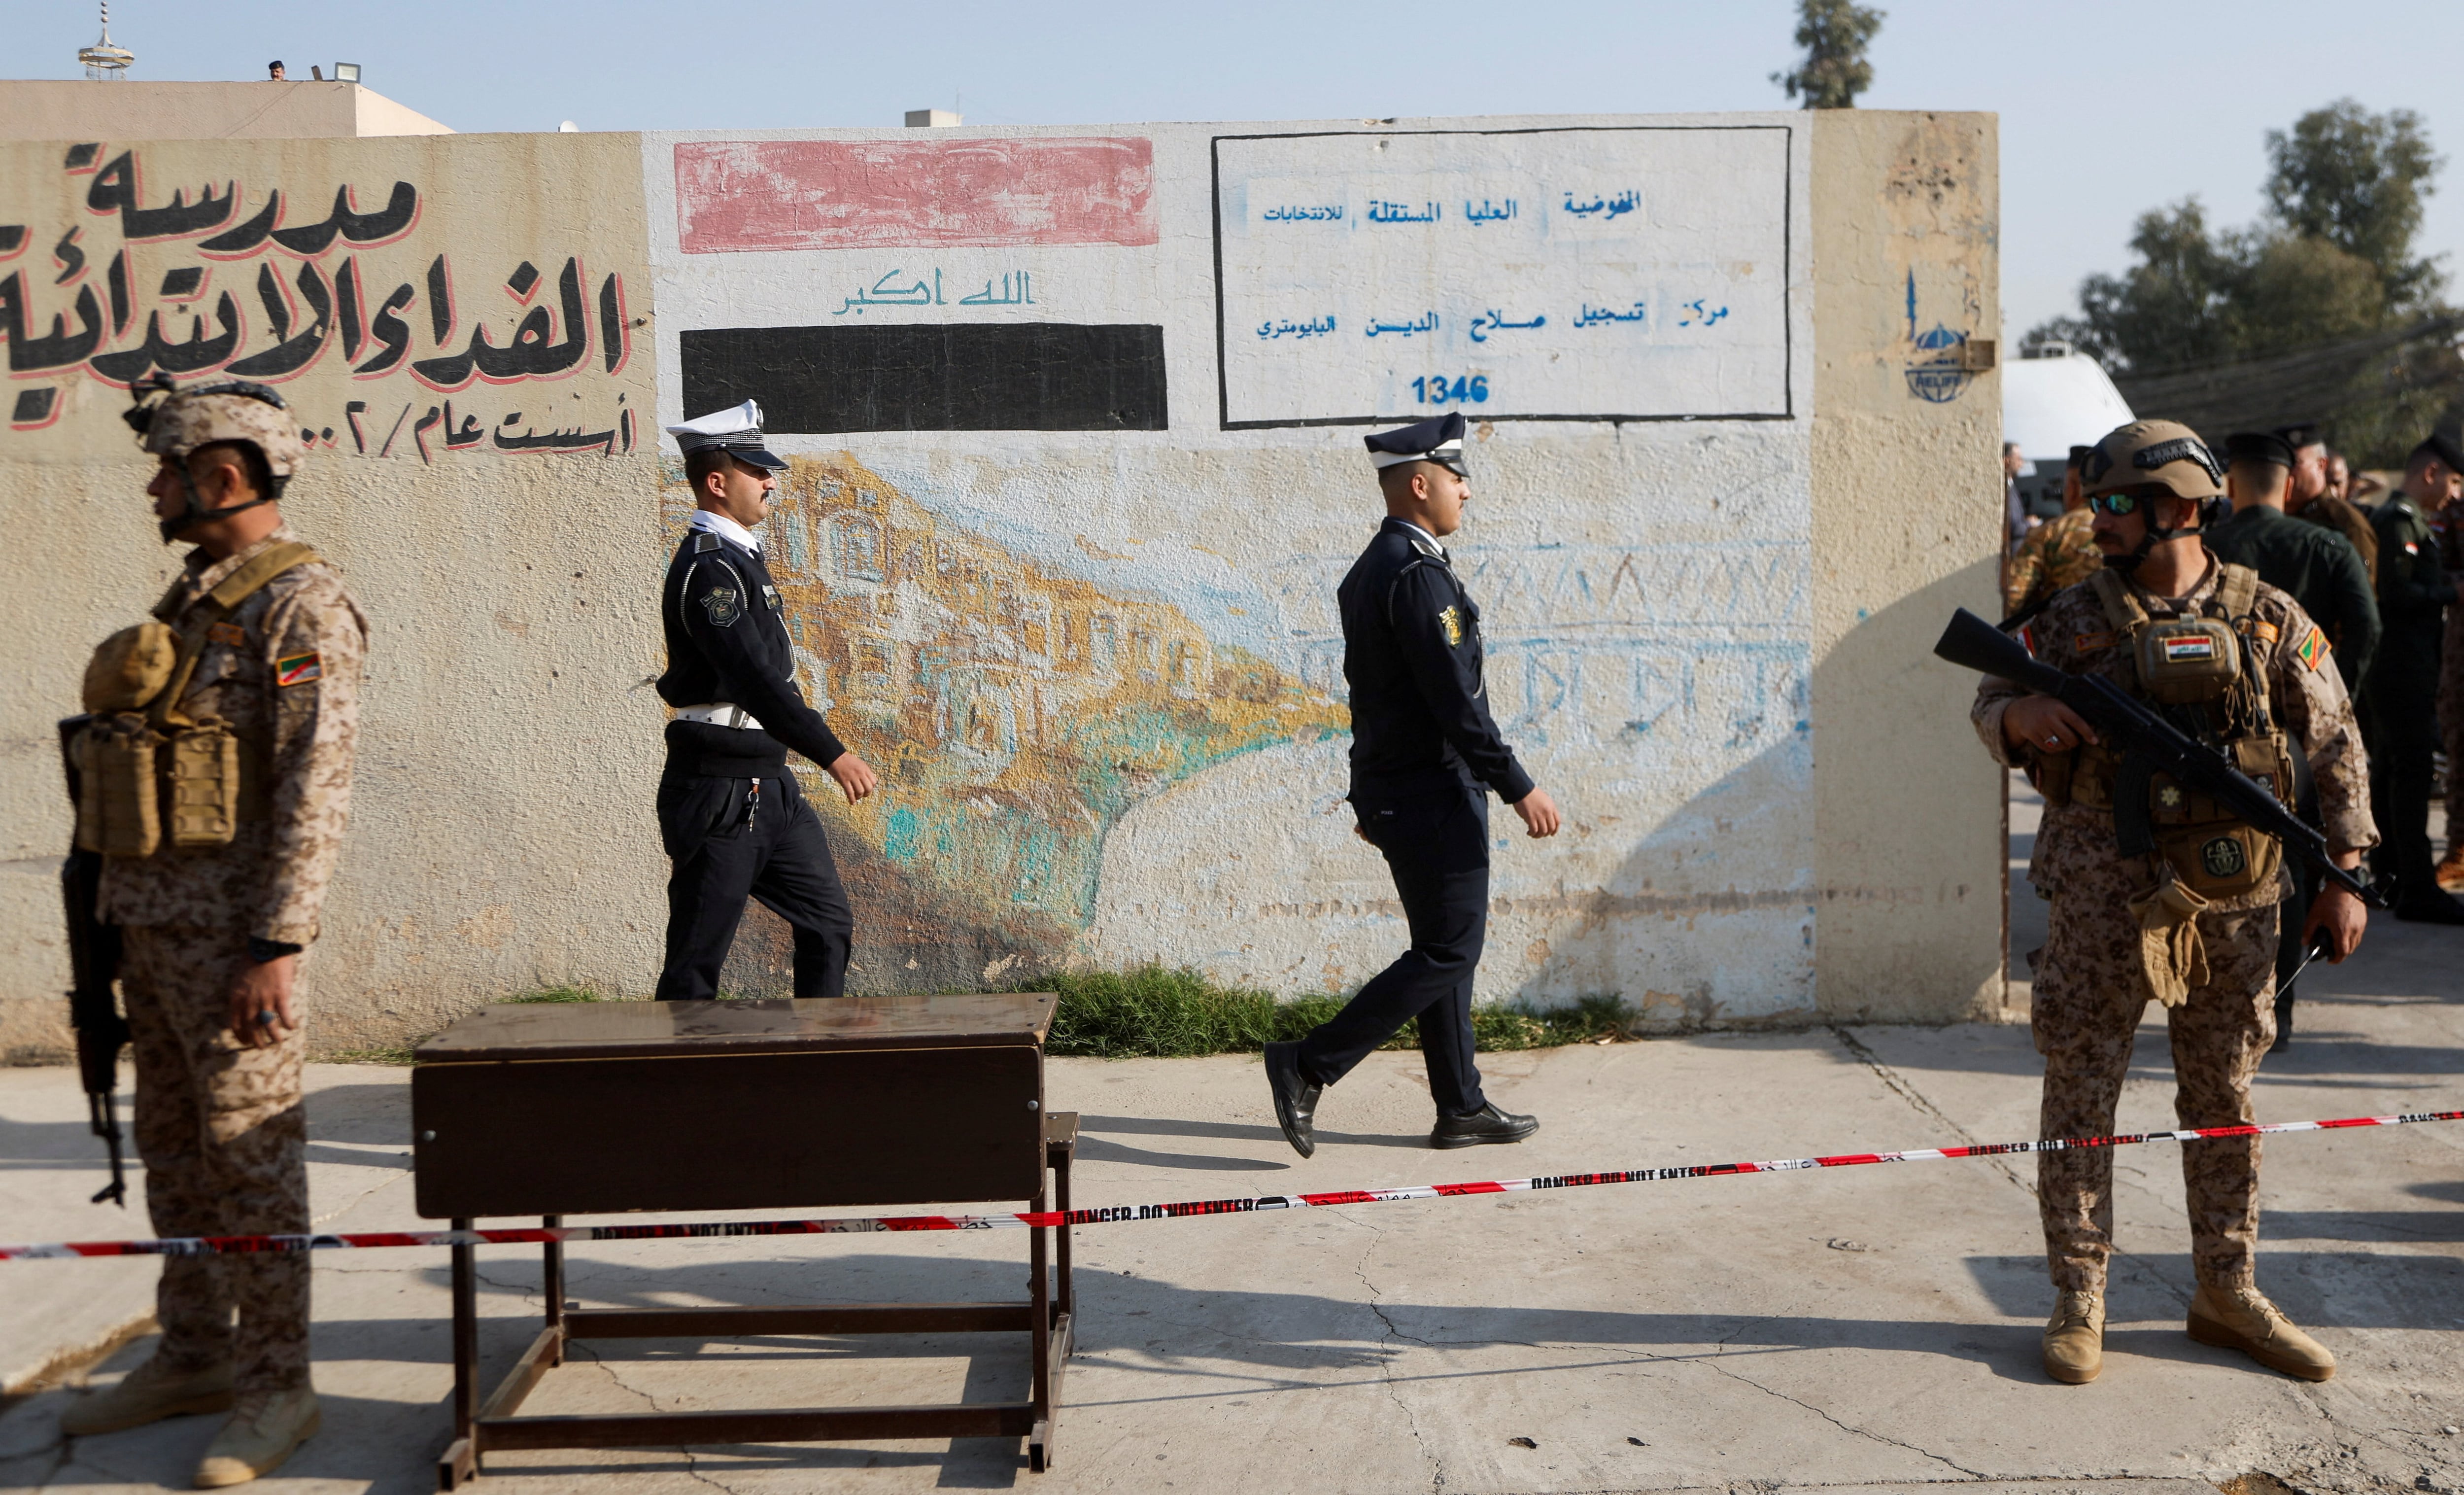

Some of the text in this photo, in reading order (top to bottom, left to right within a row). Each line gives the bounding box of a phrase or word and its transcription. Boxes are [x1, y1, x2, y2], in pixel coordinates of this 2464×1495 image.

[63, 143, 424, 261] مدرسة
[1263, 205, 1343, 222] للانتخابات
[1368, 199, 1441, 224] المستقلة
[1465, 198, 1518, 226] العليا
[832, 268, 1035, 315] الله اكبر
[354, 252, 632, 393] الفداء
[1257, 314, 1337, 340] البايومتري
[1366, 311, 1440, 338] الدين
[1468, 309, 1547, 343] صلاح
[1574, 302, 1646, 328] تسجيل
[1411, 375, 1490, 406] 1346
[493, 392, 637, 459] أسست
[1167, 1201, 1200, 1217] NOT
[1204, 1198, 1253, 1215] ENTER
